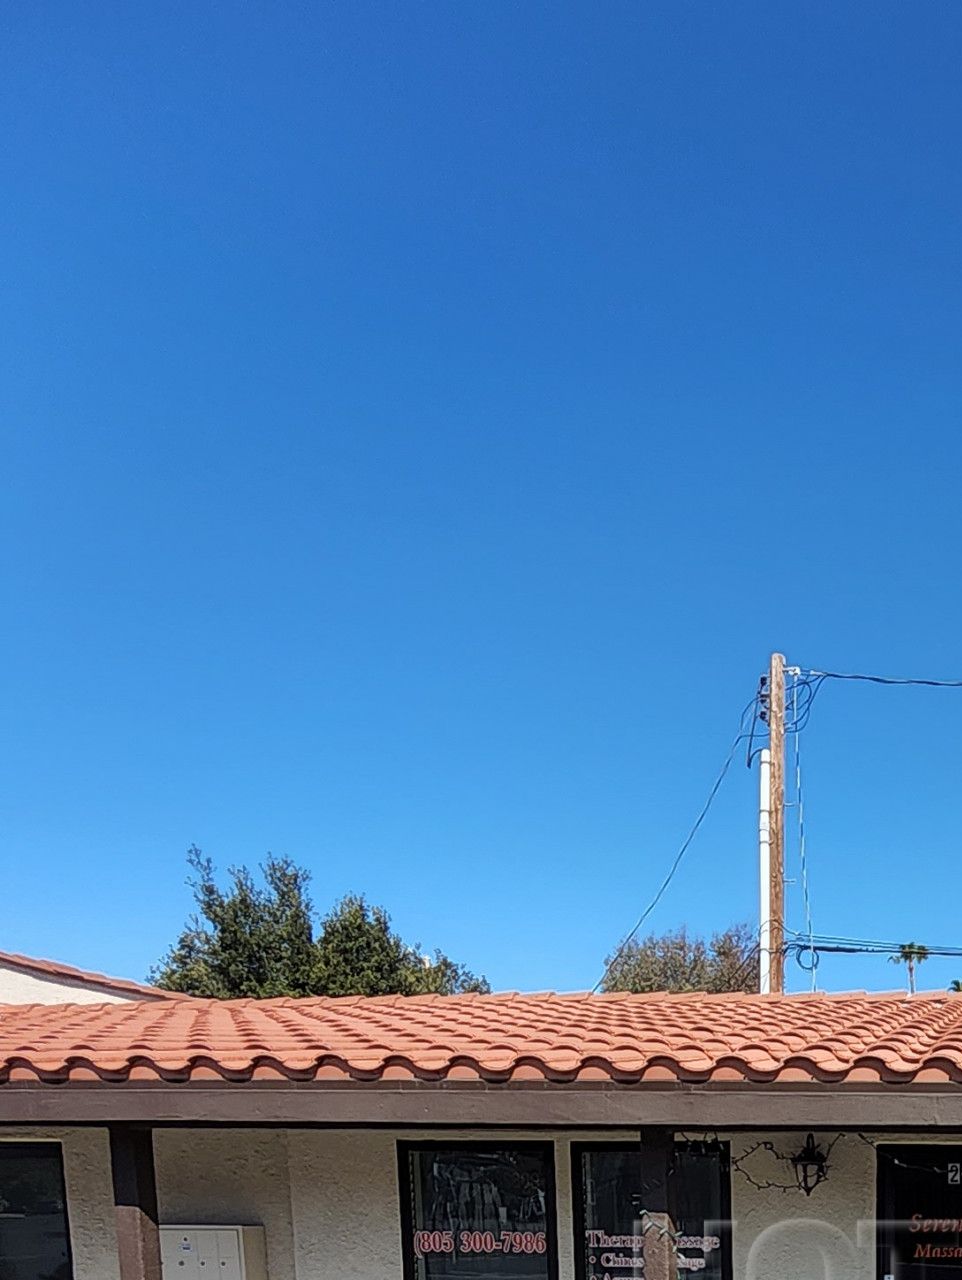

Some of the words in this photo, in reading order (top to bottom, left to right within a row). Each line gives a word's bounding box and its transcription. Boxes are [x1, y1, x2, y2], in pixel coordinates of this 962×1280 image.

[948, 1164, 960, 1183] 2
[460, 1230, 547, 1254] 300-7986
[585, 1230, 644, 1252] Therap
